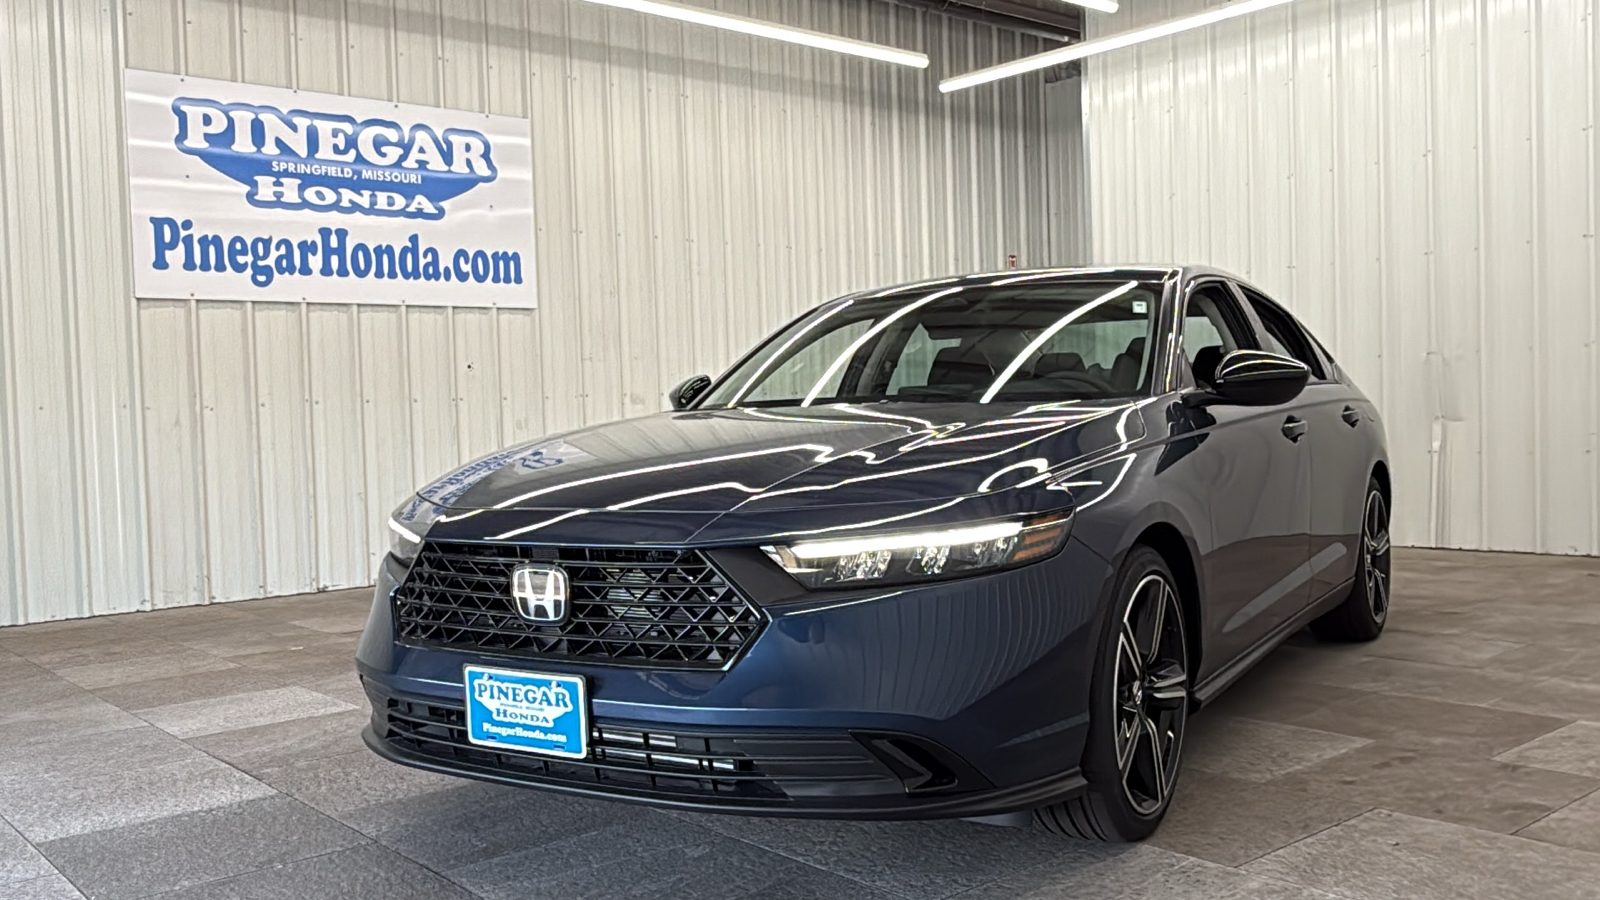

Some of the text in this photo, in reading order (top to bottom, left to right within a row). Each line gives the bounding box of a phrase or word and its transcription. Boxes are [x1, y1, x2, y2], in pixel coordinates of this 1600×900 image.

[180, 104, 493, 176] PINEGAR
[271, 161, 422, 185] SPRINGFIELD, MISSOURI
[253, 175, 440, 214] HONDA
[149, 216, 523, 287] PinegarHonda.com
[477, 683, 569, 708] PINEGAR
[495, 708, 550, 724] HONDA
[482, 722, 567, 743] PinegarHonda.com
